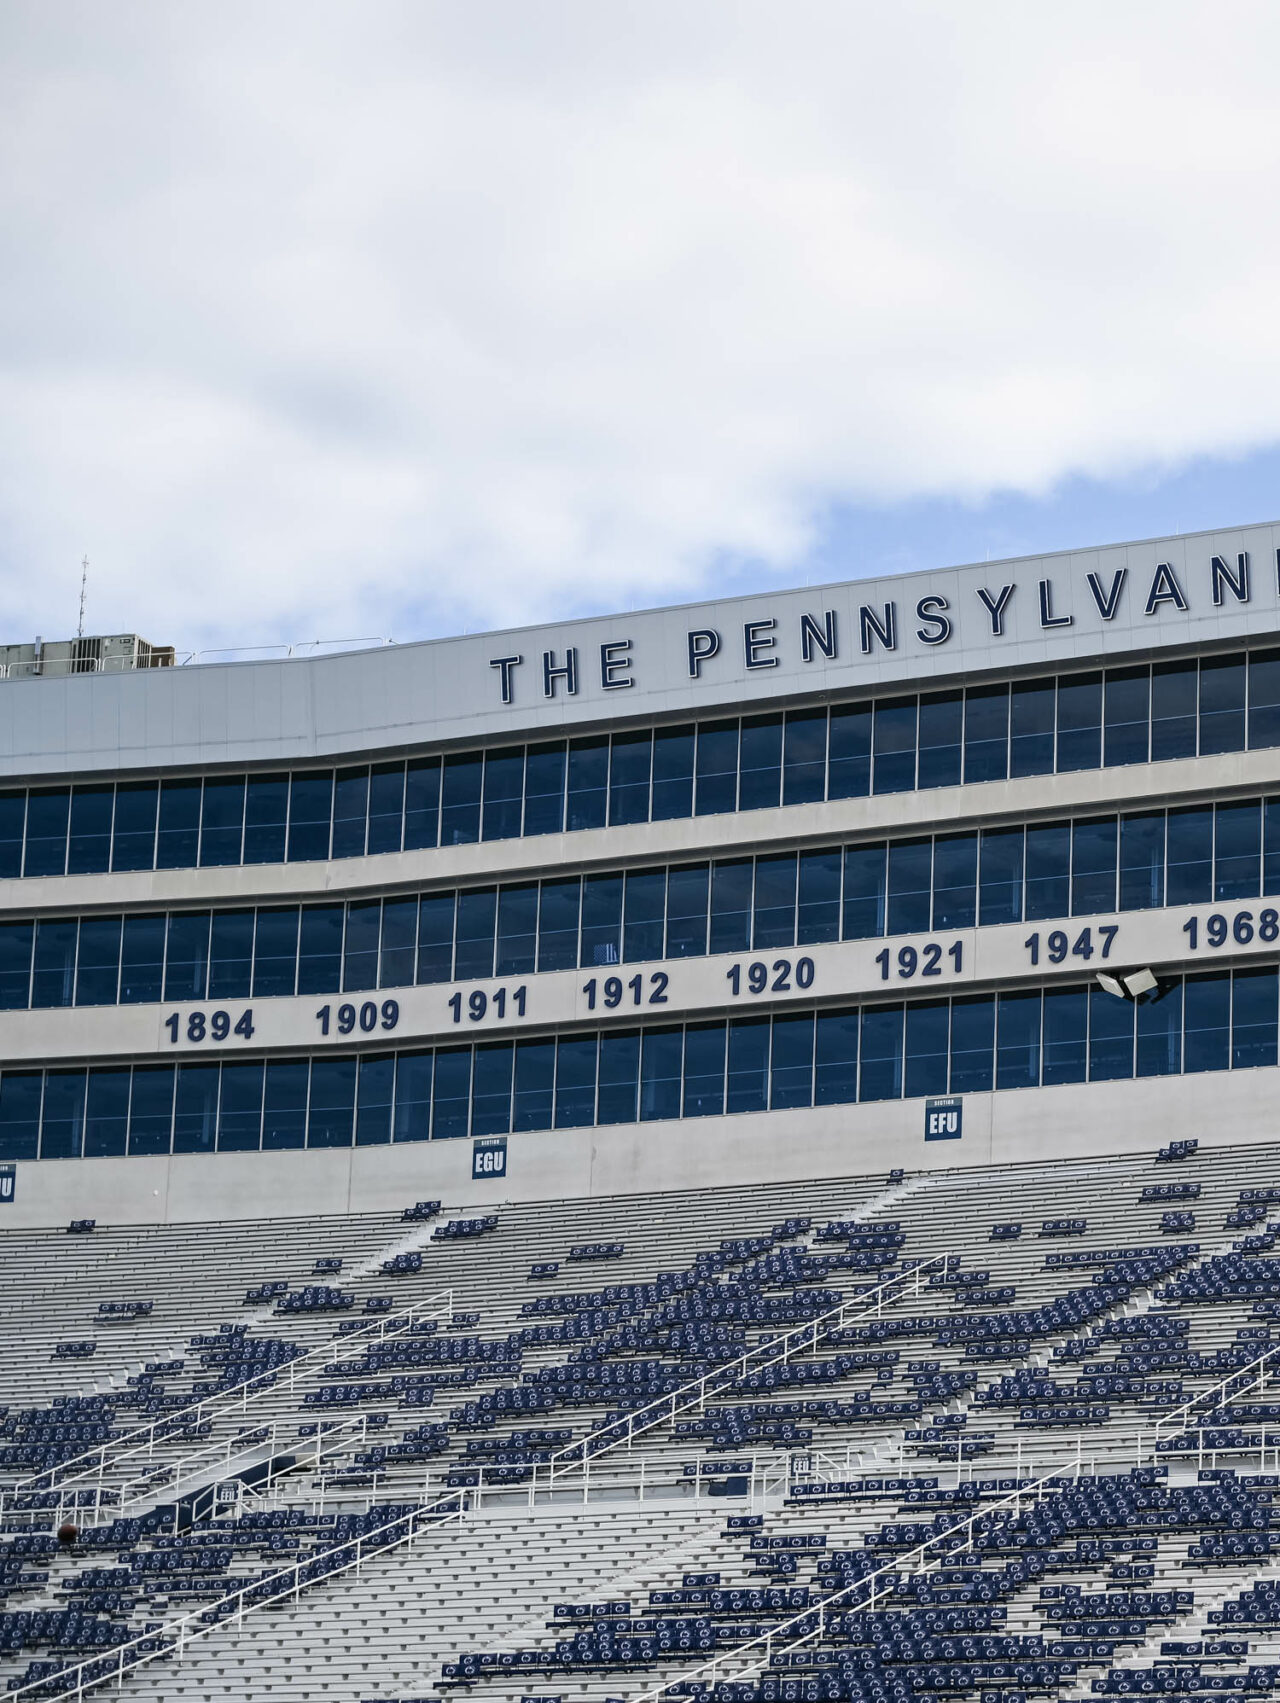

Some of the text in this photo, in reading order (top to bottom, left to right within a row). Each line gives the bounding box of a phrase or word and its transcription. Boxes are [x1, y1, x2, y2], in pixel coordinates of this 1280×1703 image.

[489, 638, 634, 704] THE
[164, 1008, 256, 1044] 1894
[315, 999, 400, 1036] 1909
[448, 985, 528, 1024] 1911
[582, 971, 670, 1011] 1912
[726, 956, 816, 996] 1920
[875, 940, 964, 981] 1921
[1024, 924, 1119, 966] 1947
[1182, 908, 1280, 950] 1968
[929, 1112, 957, 1134] EFU
[475, 1151, 504, 1173] EGU
